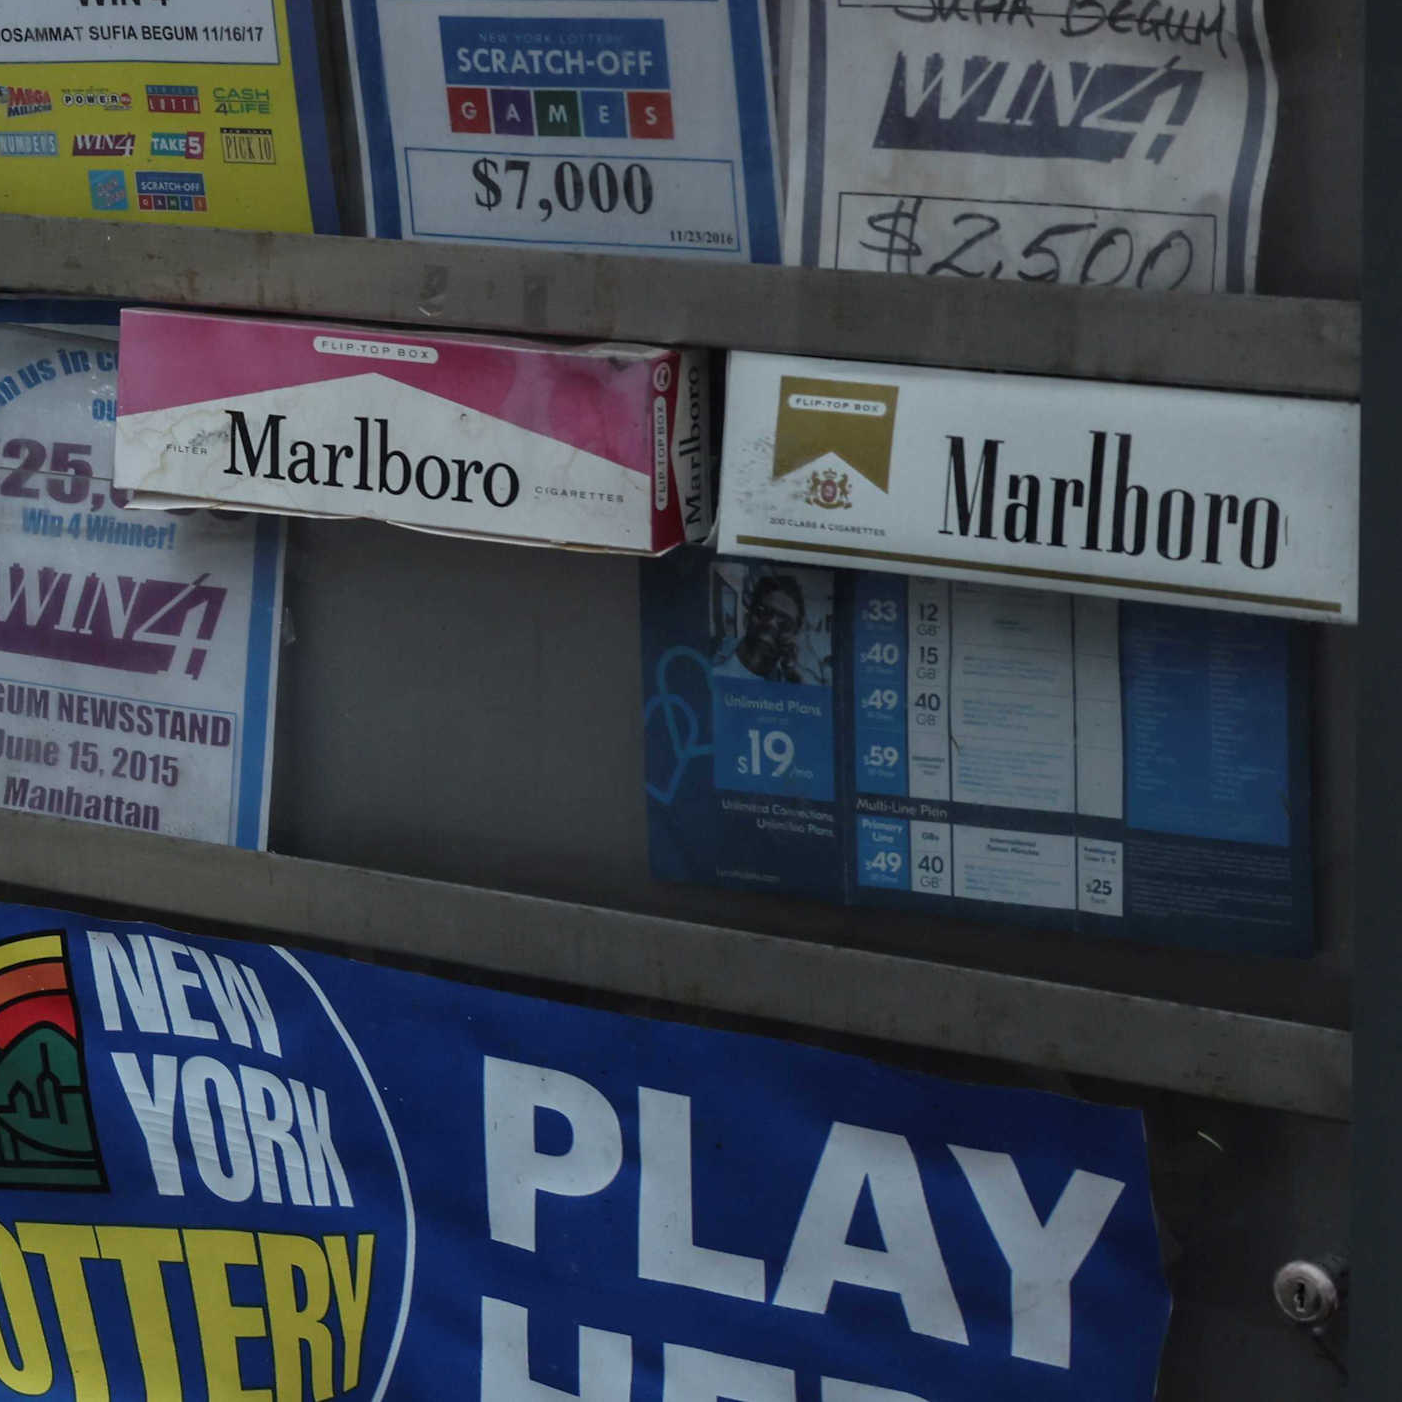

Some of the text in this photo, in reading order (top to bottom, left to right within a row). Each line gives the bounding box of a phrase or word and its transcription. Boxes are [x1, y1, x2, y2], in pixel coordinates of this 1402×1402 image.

[89, 25, 138, 43] SUFIA
[141, 25, 198, 43] BEGUM
[201, 24, 263, 43] 11/16/17
[457, 46, 653, 77] SCRATCH-OFF
[212, 87, 269, 99] CASH
[215, 102, 271, 114] 4LIFE
[152, 137, 201, 155] TAKE 5
[472, 157, 654, 221] $7,000
[322, 340, 430, 360] FLIP-TOP BOX
[17, 358, 56, 389] us
[57, 349, 92, 376] in
[795, 396, 880, 414] FLIP-TOP BOX
[166, 409, 624, 508] FILTER Marlboro CIGARETTES
[938, 430, 1280, 570] Marlboro
[66, 511, 80, 539] 4
[85, 515, 176, 551] Winner!
[917, 602, 939, 622] 12
[917, 646, 938, 665] 15
[58, 682, 232, 747] NEWSSTAND
[914, 692, 941, 712] 40
[68, 740, 99, 776] 15,
[112, 747, 179, 788] 2015
[3, 776, 160, 832] Manhattan
[917, 855, 944, 875] 40
[86, 930, 283, 1059] NEW
[110, 1051, 355, 1208] YORK
[482, 1053, 1127, 1371] PLAY
